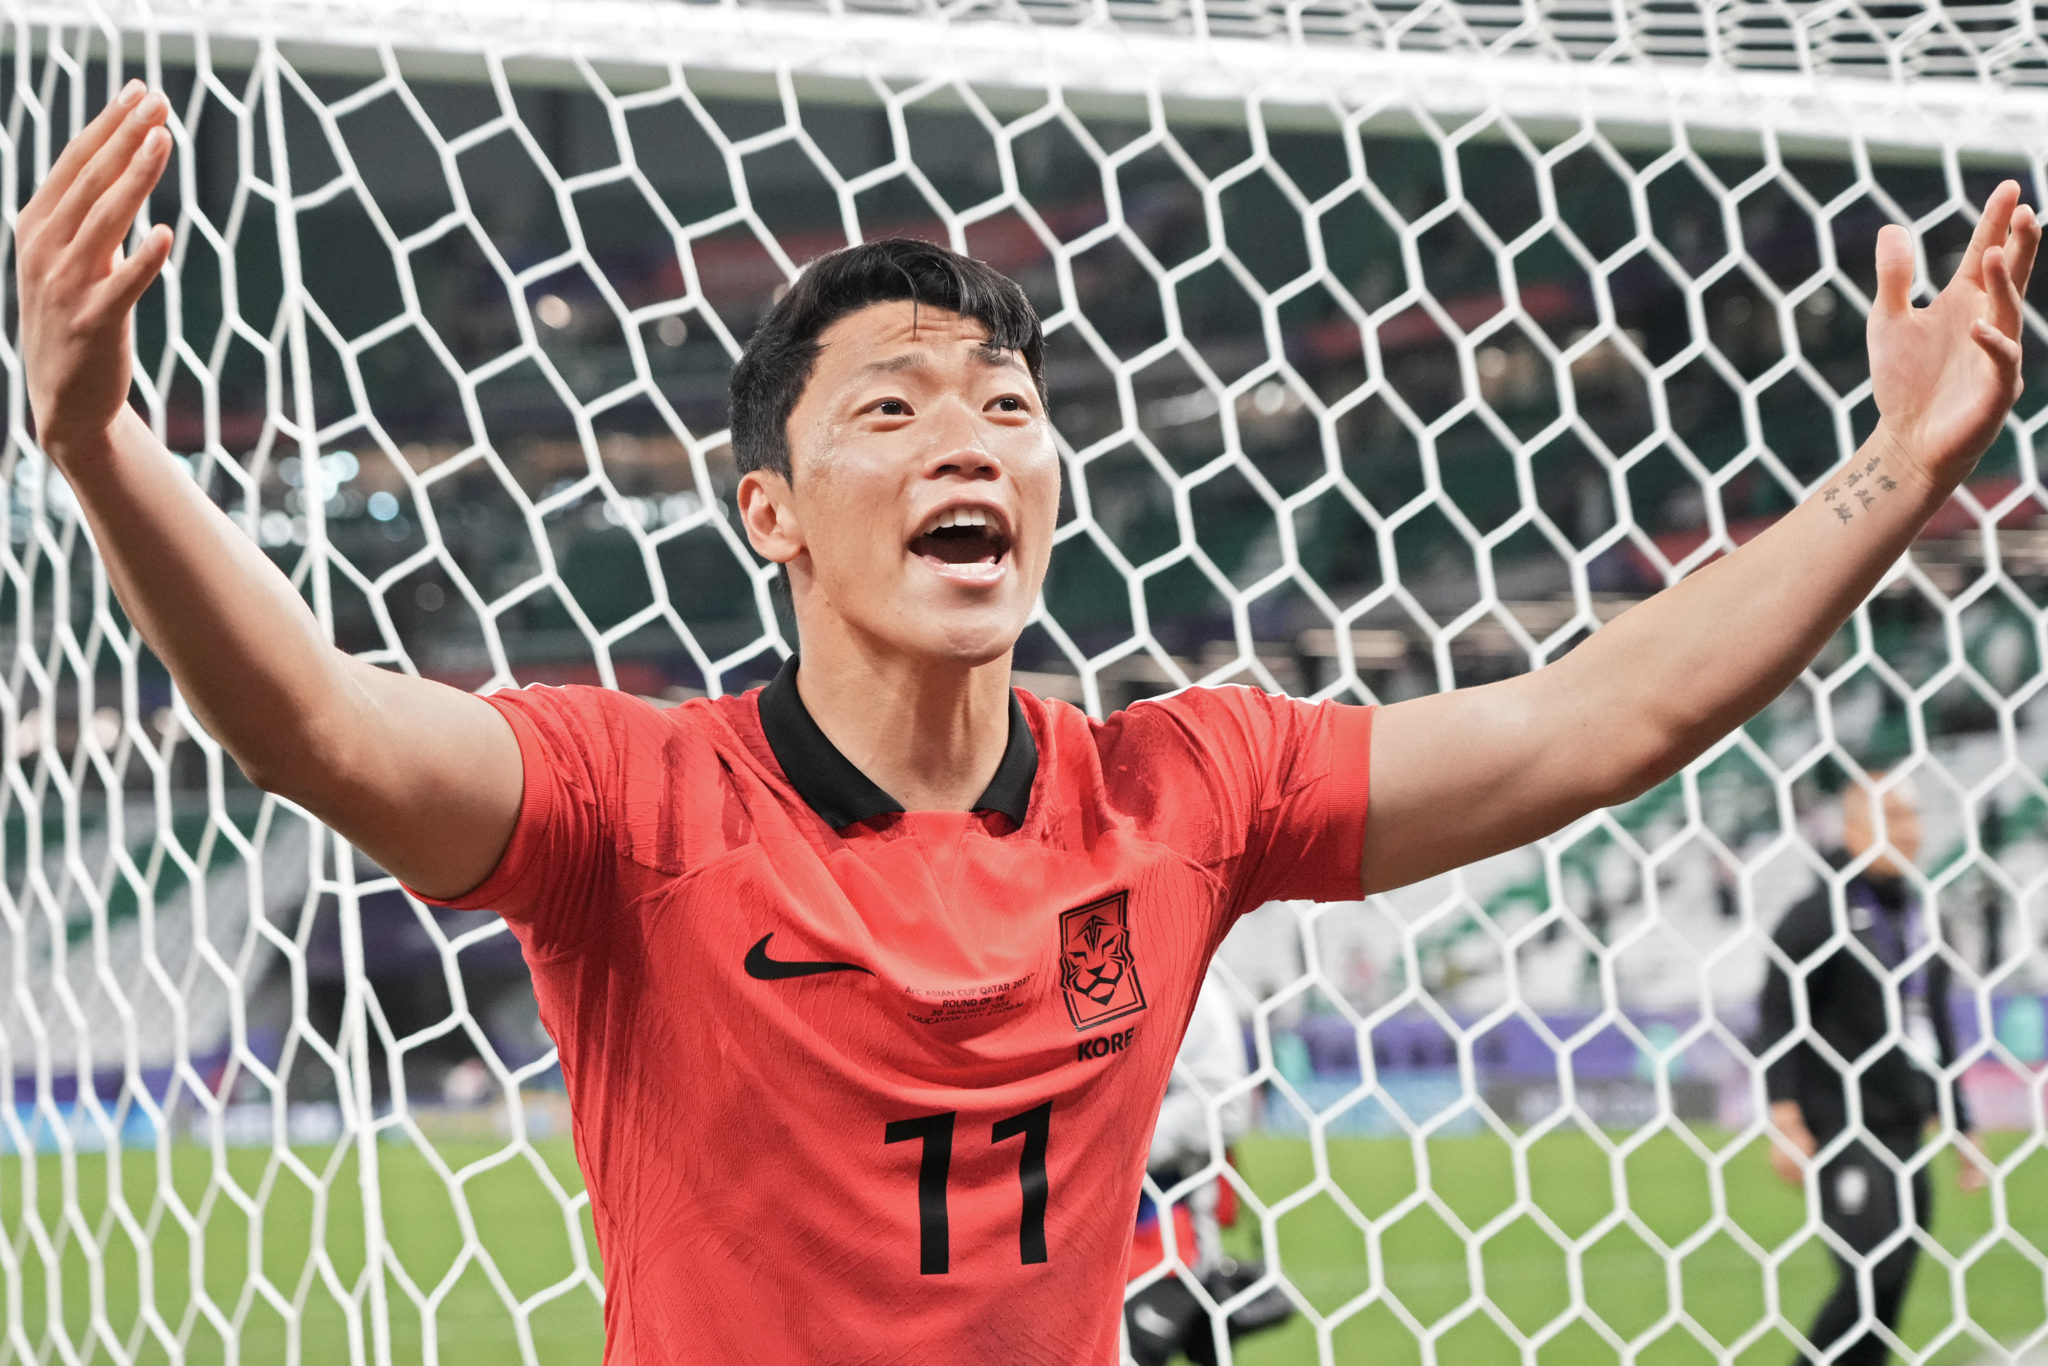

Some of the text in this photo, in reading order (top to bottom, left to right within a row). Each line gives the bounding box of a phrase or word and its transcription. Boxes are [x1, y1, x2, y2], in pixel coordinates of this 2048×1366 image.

[980, 983, 1010, 994] QATAR
[943, 999, 977, 1008] ROUND
[979, 997, 993, 1006] OF
[931, 1009, 944, 1017] 30
[1077, 1026, 1136, 1062] KORE
[884, 1100, 1053, 1276] 11
